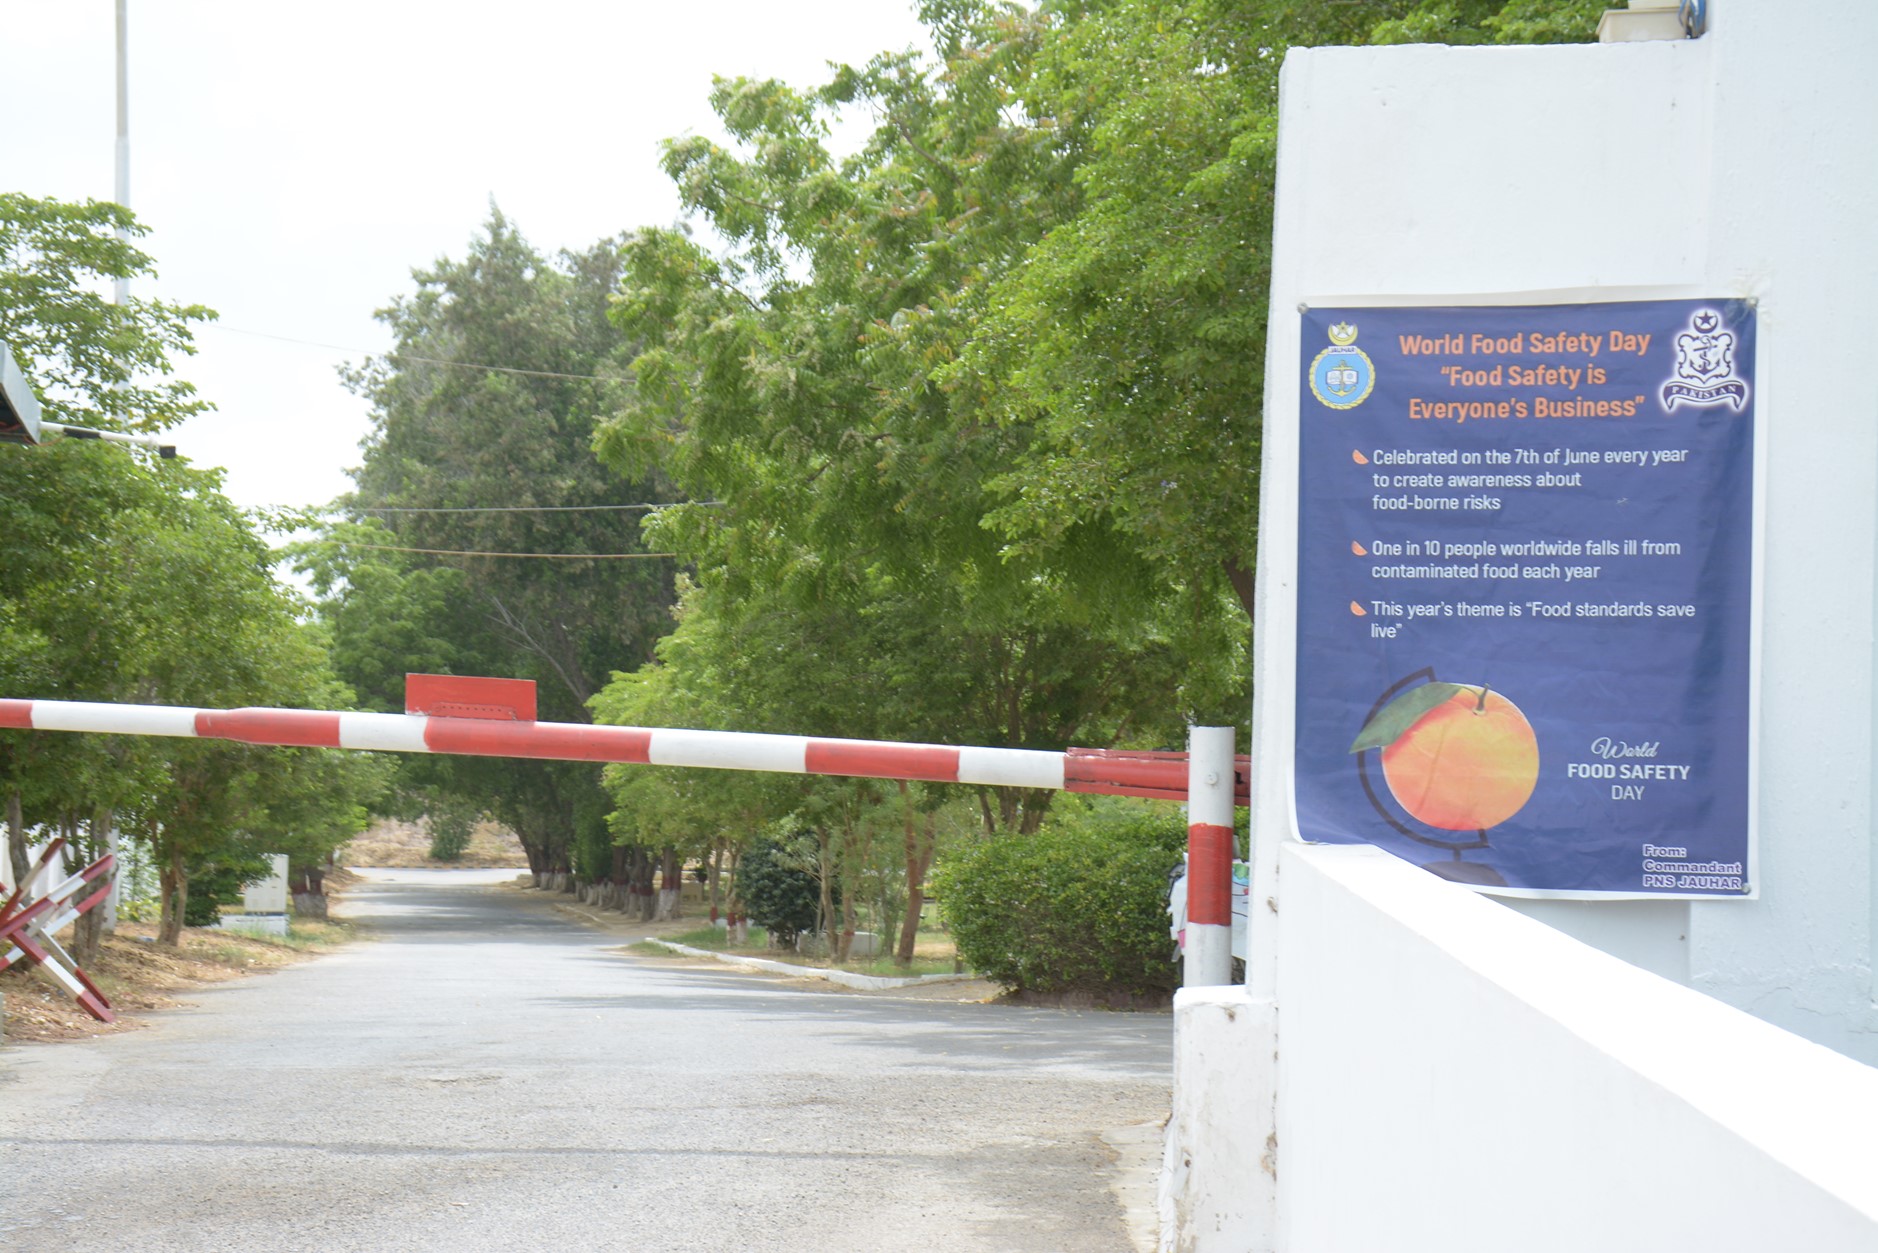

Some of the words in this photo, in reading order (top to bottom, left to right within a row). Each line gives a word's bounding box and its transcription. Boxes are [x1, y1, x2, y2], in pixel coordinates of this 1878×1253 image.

[1399, 334, 1463, 354] World
[1472, 333, 1522, 354] Food
[1529, 332, 1602, 356] Safety
[1610, 331, 1651, 355] Day
[1508, 365, 1581, 389] Safety
[1587, 364, 1606, 384] is
[1672, 386, 1736, 398] PAKISTAN
[1373, 450, 1457, 465] Celebrated
[1462, 453, 1481, 464] on
[1486, 450, 1511, 464] the
[1515, 450, 1539, 464] 7th
[1544, 449, 1560, 463] of
[1564, 449, 1600, 465] June
[1604, 451, 1648, 466] every
[1653, 450, 1687, 465] year
[1373, 474, 1389, 487] to
[1394, 474, 1443, 487] create
[1448, 474, 1531, 487] awareness
[1536, 472, 1581, 486] about
[1373, 495, 1459, 510] food-borne
[1464, 495, 1501, 510] risks
[1372, 541, 1401, 556] One
[1406, 541, 1419, 555] in
[1425, 541, 1440, 555] 10
[1445, 541, 1496, 558] people
[1501, 541, 1581, 555] worldwide
[1585, 541, 1619, 555] falls
[1624, 541, 1637, 555] ill
[1642, 541, 1680, 555] from
[1372, 564, 1478, 578] contaminated
[1483, 564, 1518, 578] food
[1523, 564, 1560, 578] each
[1565, 566, 1600, 582] year
[1371, 602, 1403, 616] This
[1457, 602, 1504, 616] theme
[1509, 602, 1521, 616] is
[1575, 602, 1652, 617] standards
[1657, 606, 1695, 617] save
[1591, 737, 1659, 759] World
[1568, 764, 1615, 778] FOOD
[1620, 765, 1690, 779] SAFETY
[1612, 785, 1645, 800] DAY
[1643, 844, 1686, 857] From:
[1642, 860, 1742, 874] Commandant
[1643, 875, 1675, 887] PNS
[1678, 876, 1742, 889] JAUHAR
